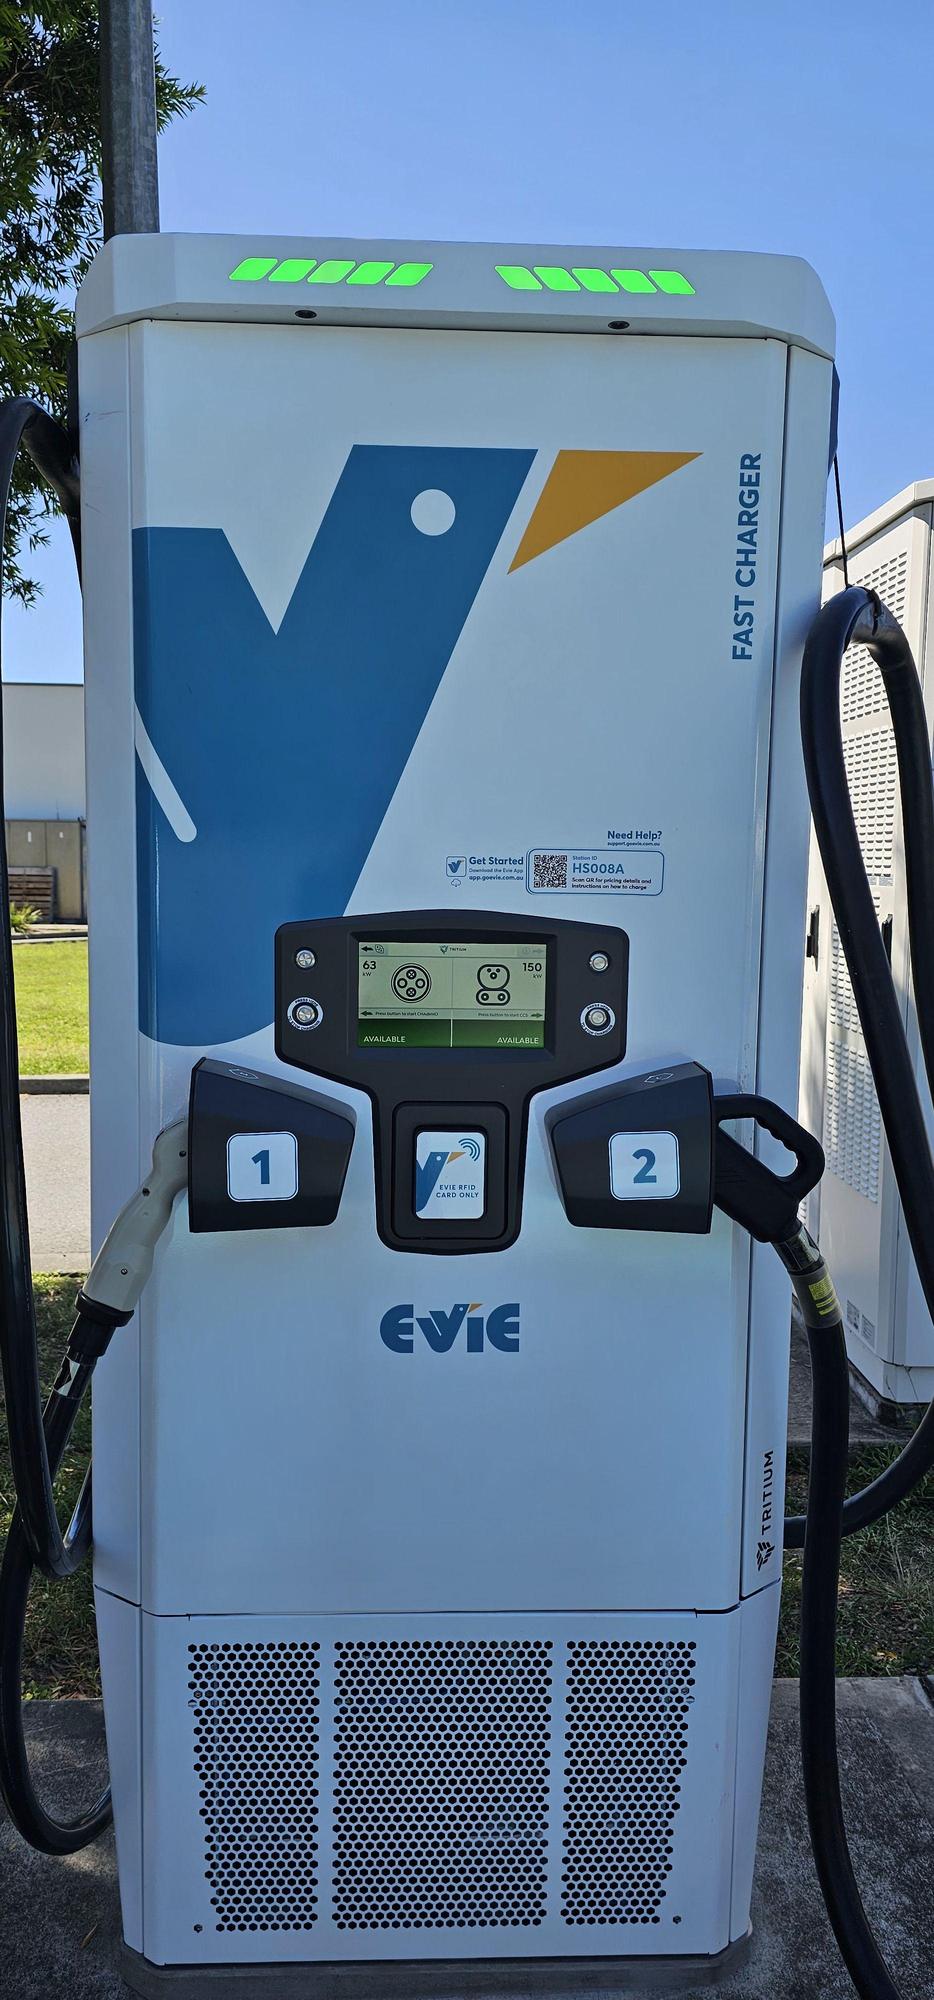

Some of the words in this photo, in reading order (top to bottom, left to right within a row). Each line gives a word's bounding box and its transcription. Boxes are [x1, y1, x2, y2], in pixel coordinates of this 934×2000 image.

[735, 453, 761, 588] CHARGER
[732, 594, 754, 660] FAST
[607, 830, 633, 840] Need
[635, 830, 662, 842] Help?
[469, 856, 486, 865] Get
[488, 856, 524, 865] Started
[572, 863, 625, 875] HS008A
[363, 960, 377, 970] 63
[522, 962, 542, 972] 150
[363, 1035, 406, 1043] AVAILABLE
[251, 1149, 270, 1185] 1
[632, 1148, 657, 1184] 2
[761, 1449, 774, 1536] TRITIUM
